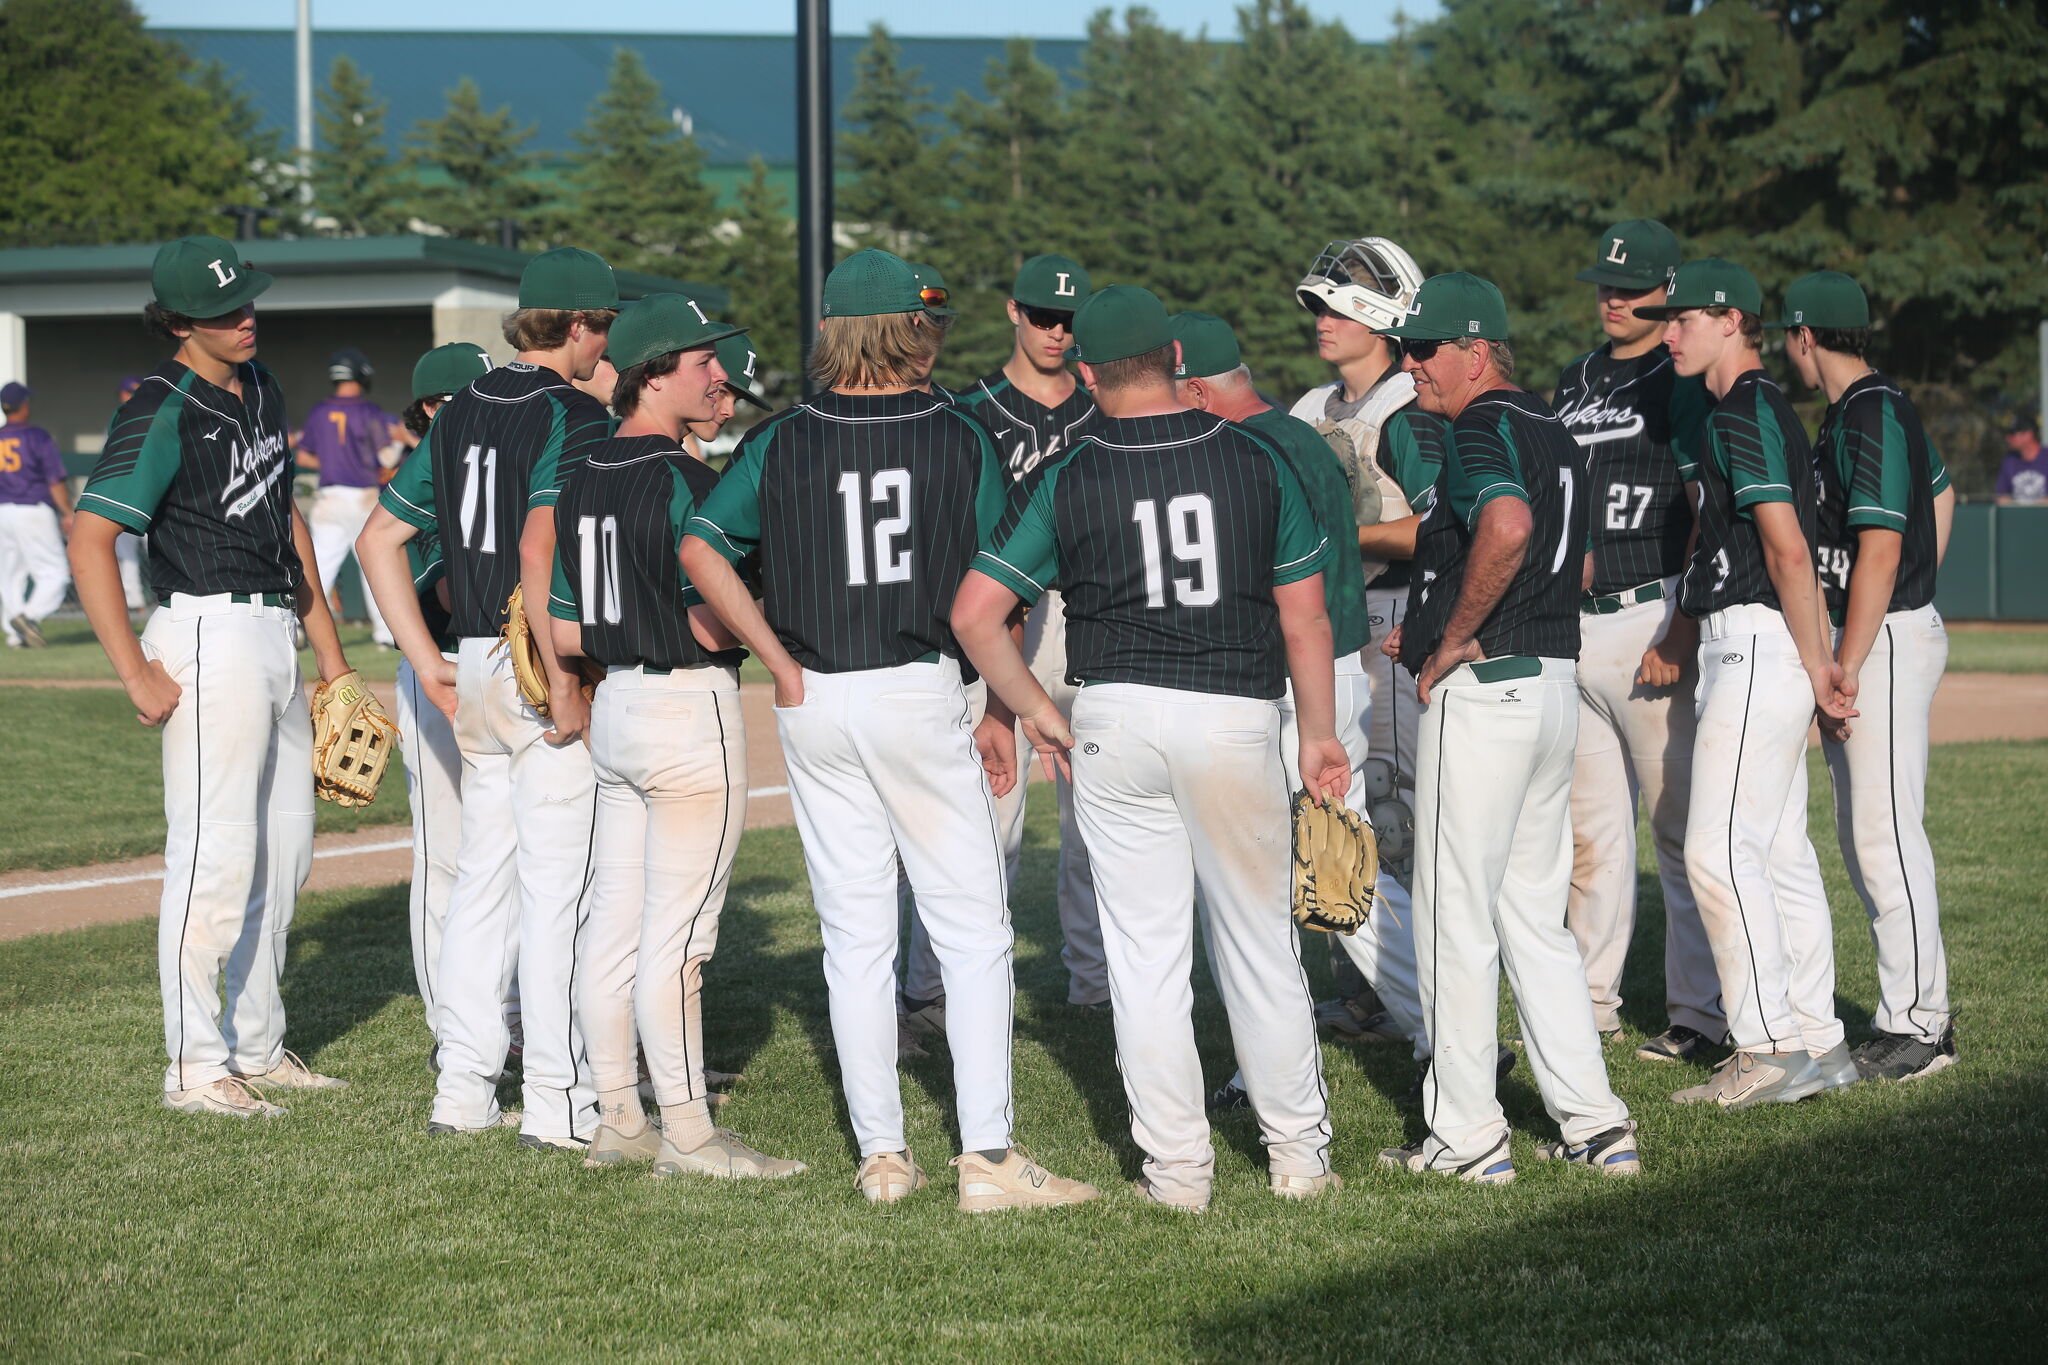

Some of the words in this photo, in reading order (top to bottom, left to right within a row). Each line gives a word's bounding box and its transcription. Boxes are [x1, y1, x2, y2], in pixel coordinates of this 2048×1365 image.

[207, 259, 238, 289] L
[1606, 238, 1627, 265] L
[1055, 272, 1076, 297] L
[328, 411, 346, 447] 7
[459, 444, 498, 554] 11
[1605, 482, 1654, 530] 27
[836, 467, 914, 586] 12
[577, 515, 622, 627] 10
[1131, 492, 1221, 610] 19
